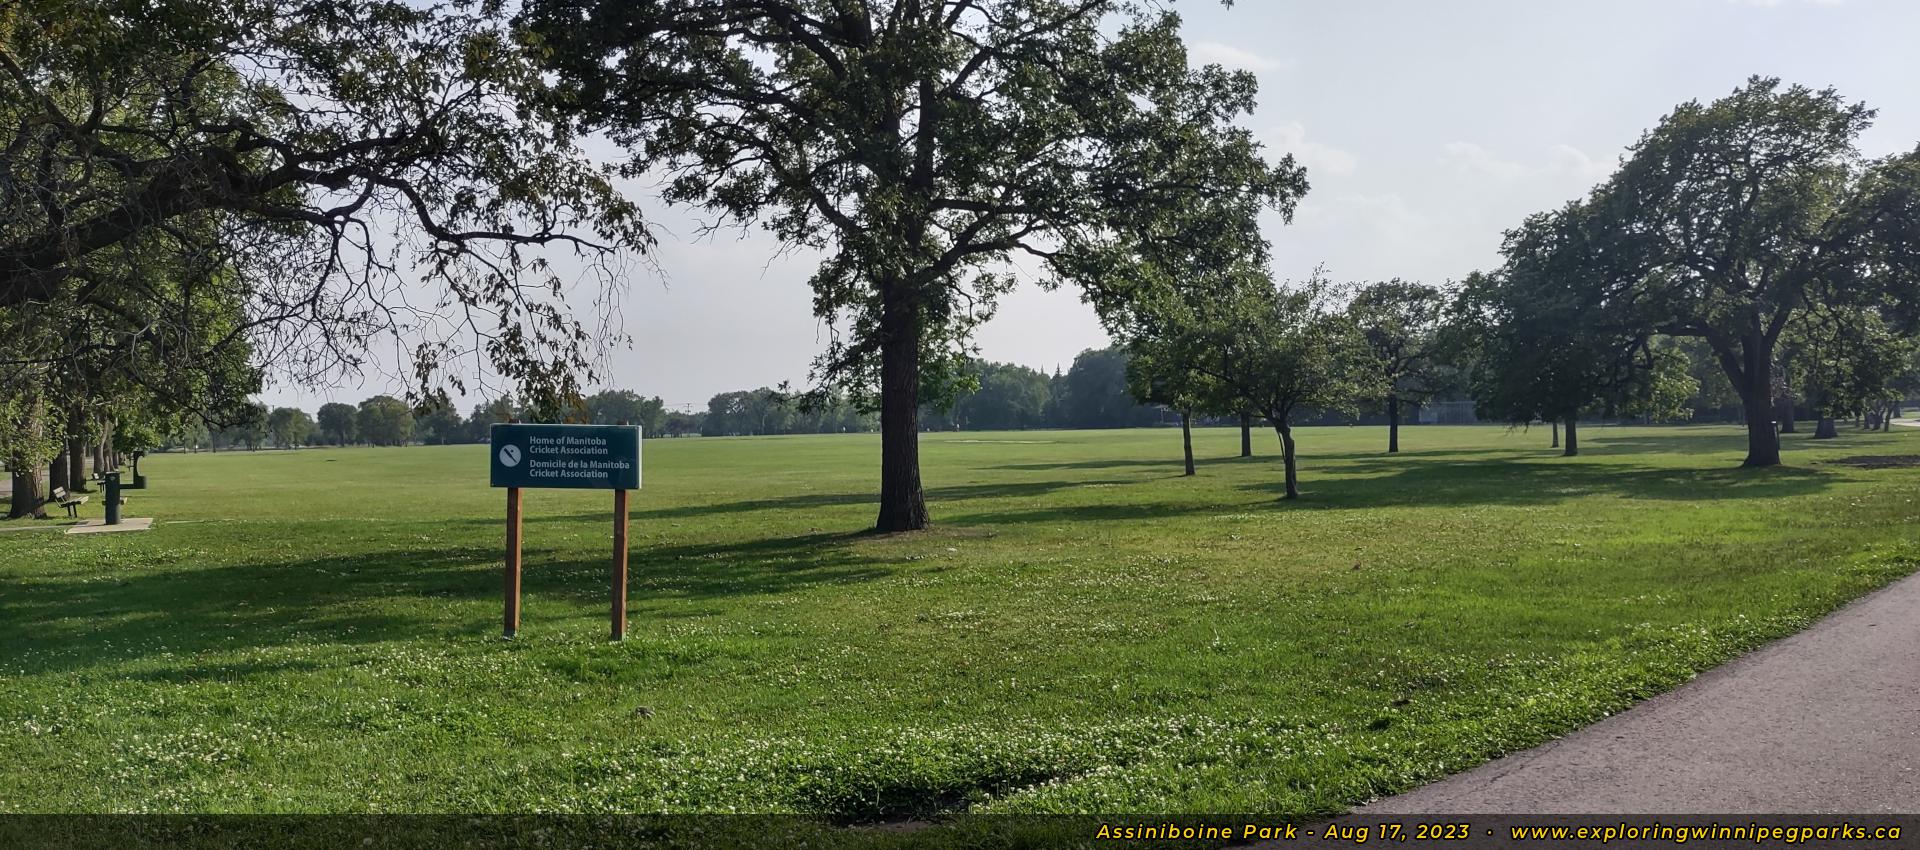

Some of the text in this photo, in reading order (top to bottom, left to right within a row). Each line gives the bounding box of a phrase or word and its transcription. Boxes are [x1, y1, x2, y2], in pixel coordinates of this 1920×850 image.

[530, 436, 606, 445] Home of Manitoba
[530, 445, 608, 455] Cricket Association
[530, 459, 630, 469] Domicile de la Manitoba
[530, 469, 608, 478] Cricket Association
